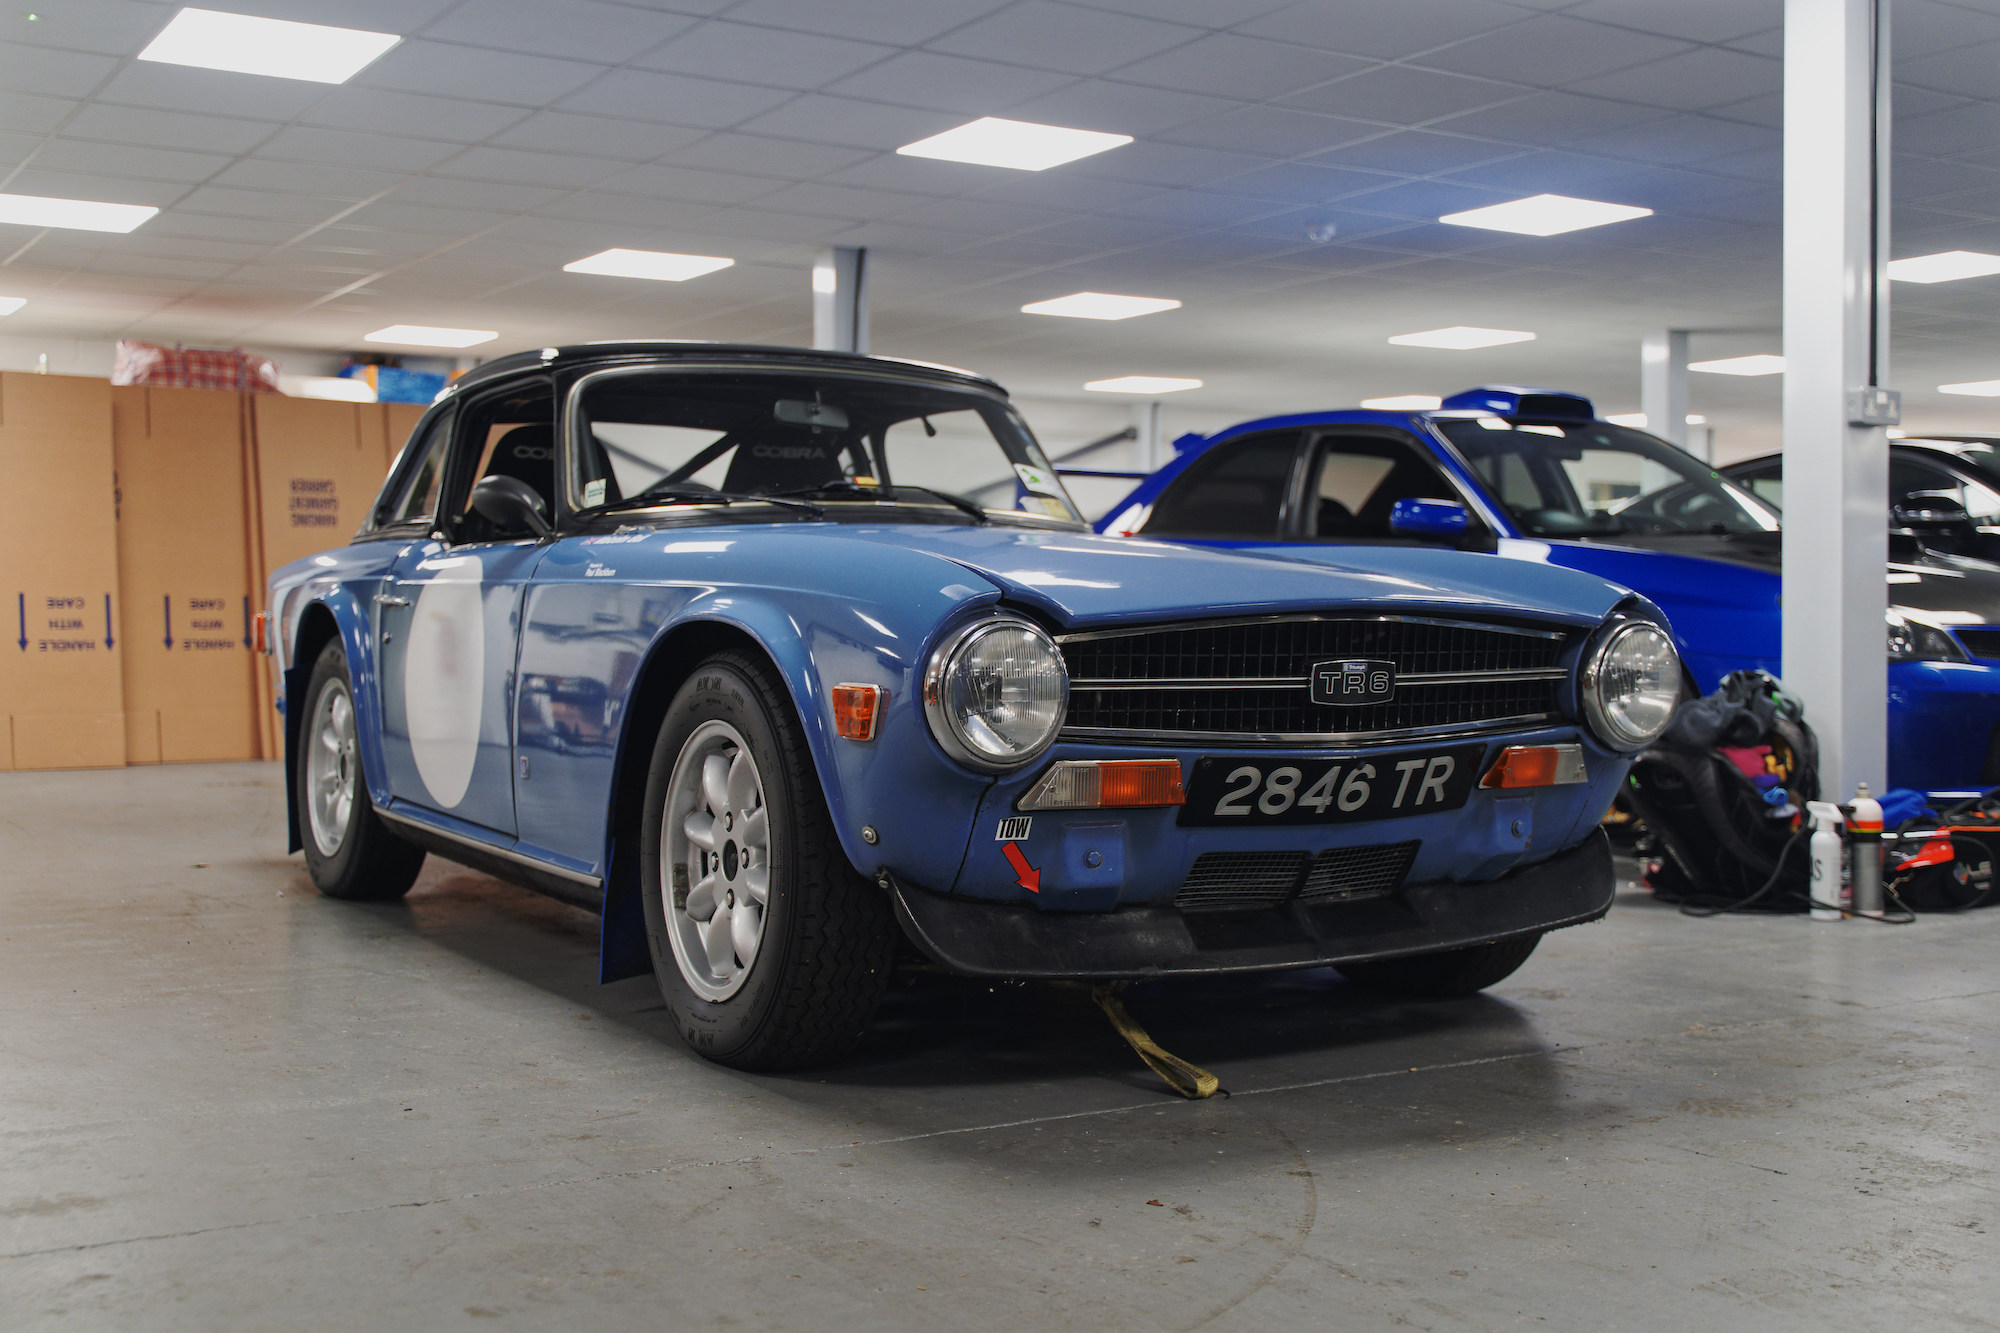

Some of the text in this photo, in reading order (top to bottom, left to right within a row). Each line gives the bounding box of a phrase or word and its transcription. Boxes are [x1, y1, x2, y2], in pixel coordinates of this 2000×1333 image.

[752, 445, 826, 459] COBRA
[46, 596, 85, 610] CARE
[189, 597, 225, 610] CARE
[48, 618, 84, 631] WITH
[191, 618, 223, 631] WITH
[38, 638, 95, 651] HANDLE
[183, 638, 235, 651] HANDLE
[1320, 671, 1389, 694] TR6
[1214, 755, 1456, 816] 2846 TR
[999, 817, 1030, 839] TOW
